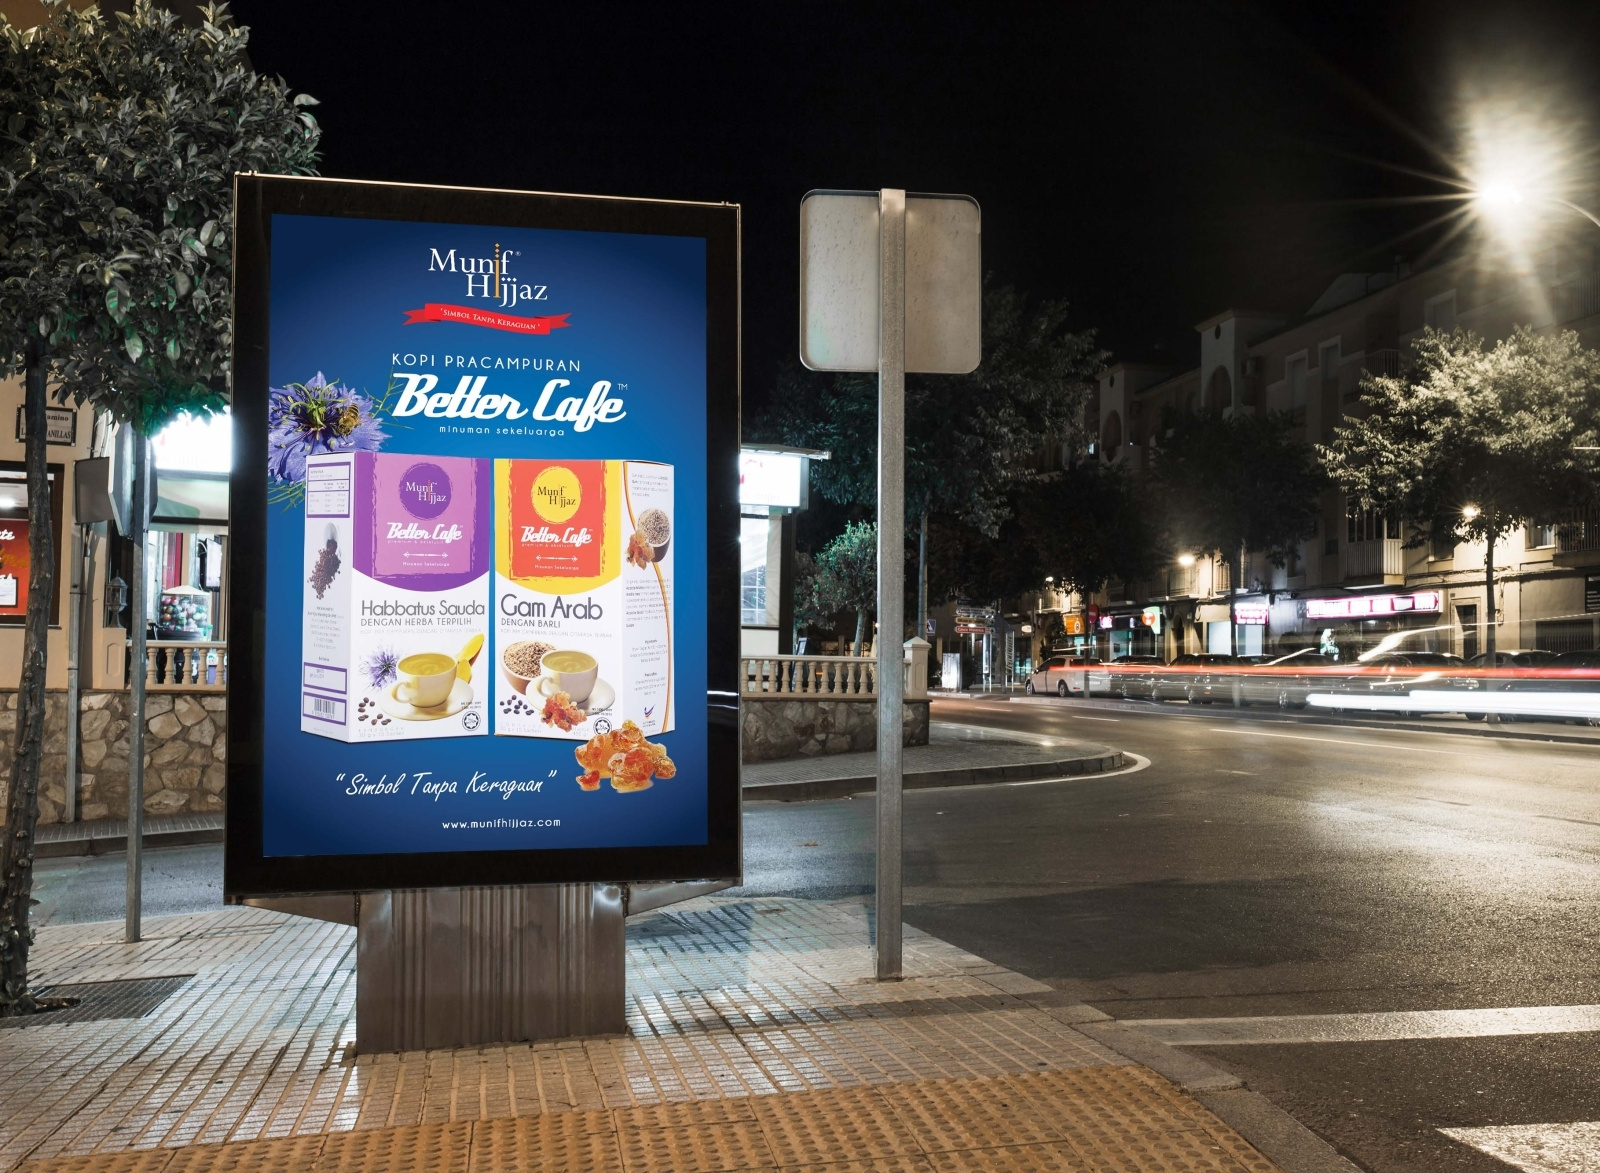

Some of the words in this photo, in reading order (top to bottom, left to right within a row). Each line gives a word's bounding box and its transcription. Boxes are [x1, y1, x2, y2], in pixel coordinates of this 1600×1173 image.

[428, 243, 514, 275] Munif
[473, 313, 496, 324] TANPA
[392, 353, 435, 367] KOPI
[445, 354, 581, 372] PRACAMPURAN
[391, 372, 529, 420] Better
[532, 378, 627, 433] Cafe
[45, 413, 69, 422] amino
[439, 425, 490, 434] minuman
[496, 427, 565, 437] sekeluarga
[386, 522, 431, 540] Better
[432, 523, 463, 544] Cafe
[521, 526, 562, 543] Better
[562, 527, 593, 548] Cafe
[361, 599, 435, 616] Habbatus
[438, 599, 485, 616] Sauda
[501, 593, 546, 618] Gam
[550, 595, 603, 620] Arab
[360, 617, 402, 627] DENGAN
[405, 617, 434, 626] HERBA
[436, 617, 472, 626] TERPILIH
[501, 617, 535, 628] DENGAN
[537, 619, 561, 629] BARLI
[411, 771, 457, 802] Tanpa
[442, 818, 562, 829] www.munifhijjaz.com
